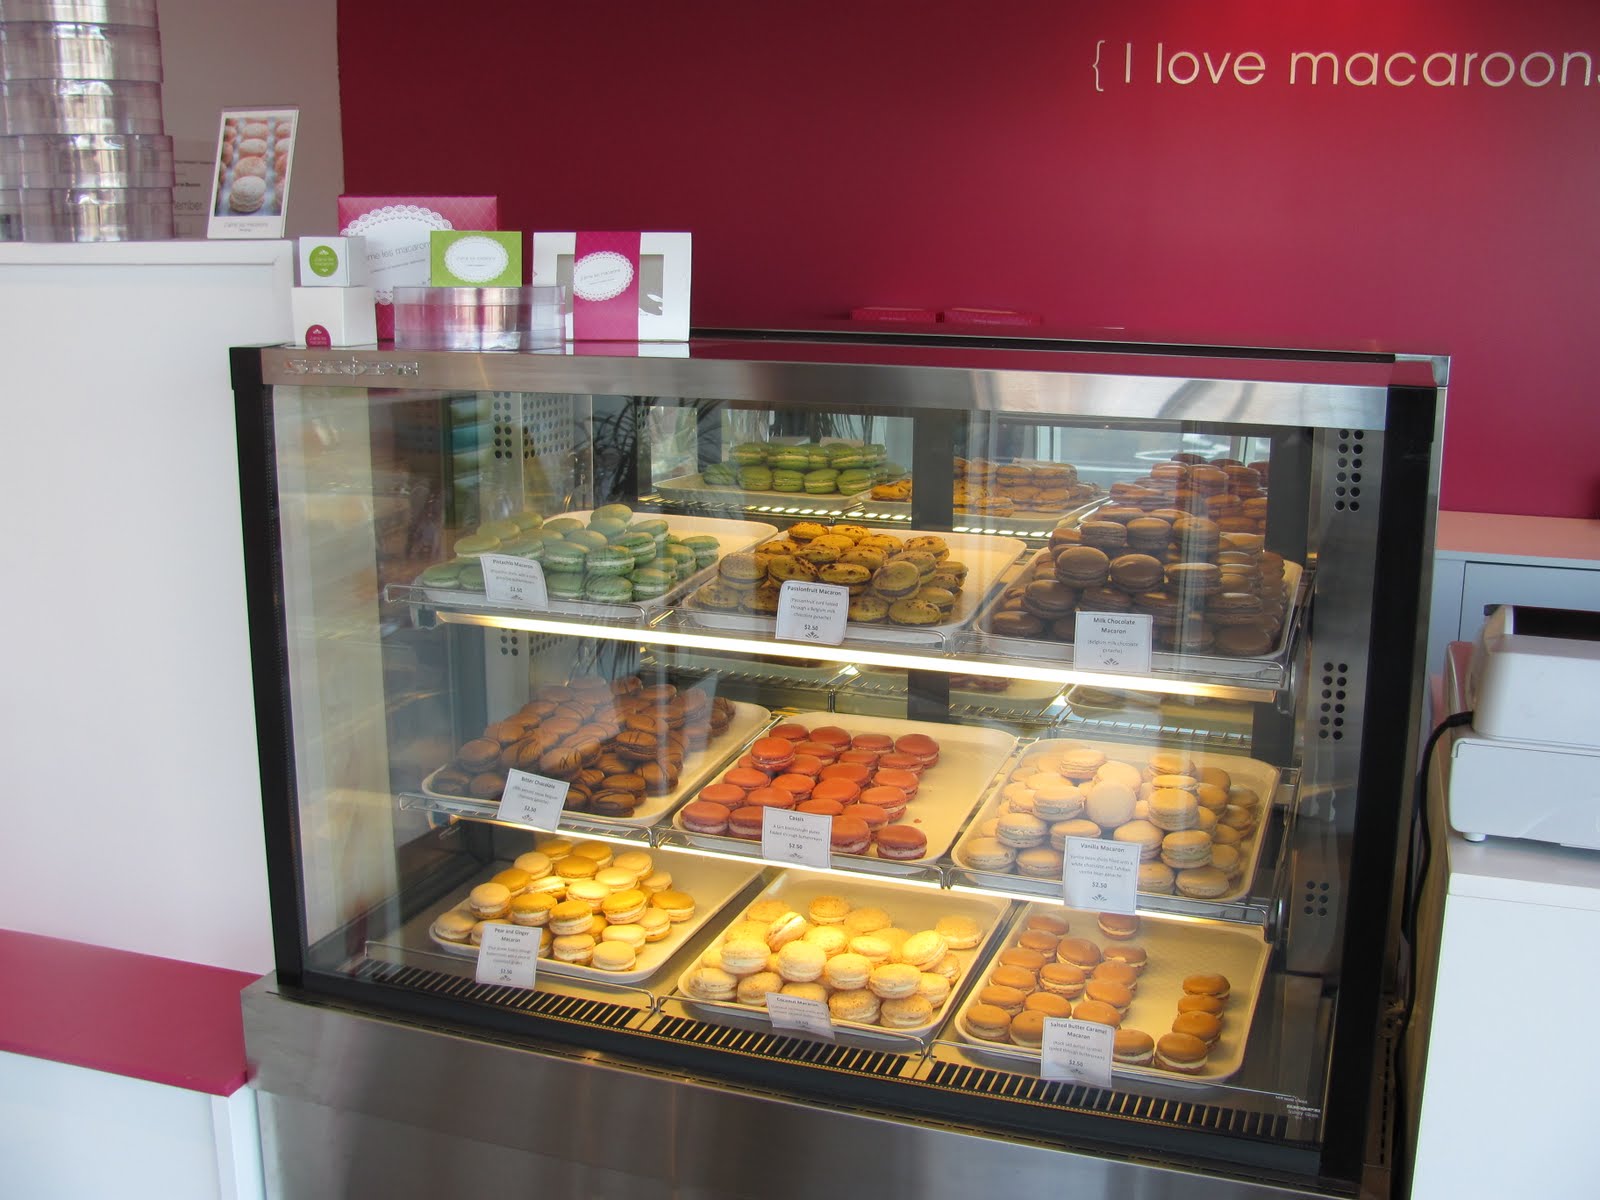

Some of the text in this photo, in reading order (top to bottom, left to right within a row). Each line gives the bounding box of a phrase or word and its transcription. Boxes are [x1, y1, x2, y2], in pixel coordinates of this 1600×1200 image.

[1125, 43, 1132, 83] I
[1156, 43, 1265, 84] love
[1290, 52, 1599, 86] macaroon
[395, 242, 430, 254] macaron
[514, 561, 534, 569] Macaron
[787, 586, 818, 594] Passionfruit
[534, 780, 555, 789] Chocolate
[1101, 845, 1124, 853] Macaron
[1086, 1026, 1107, 1034] Caramel
